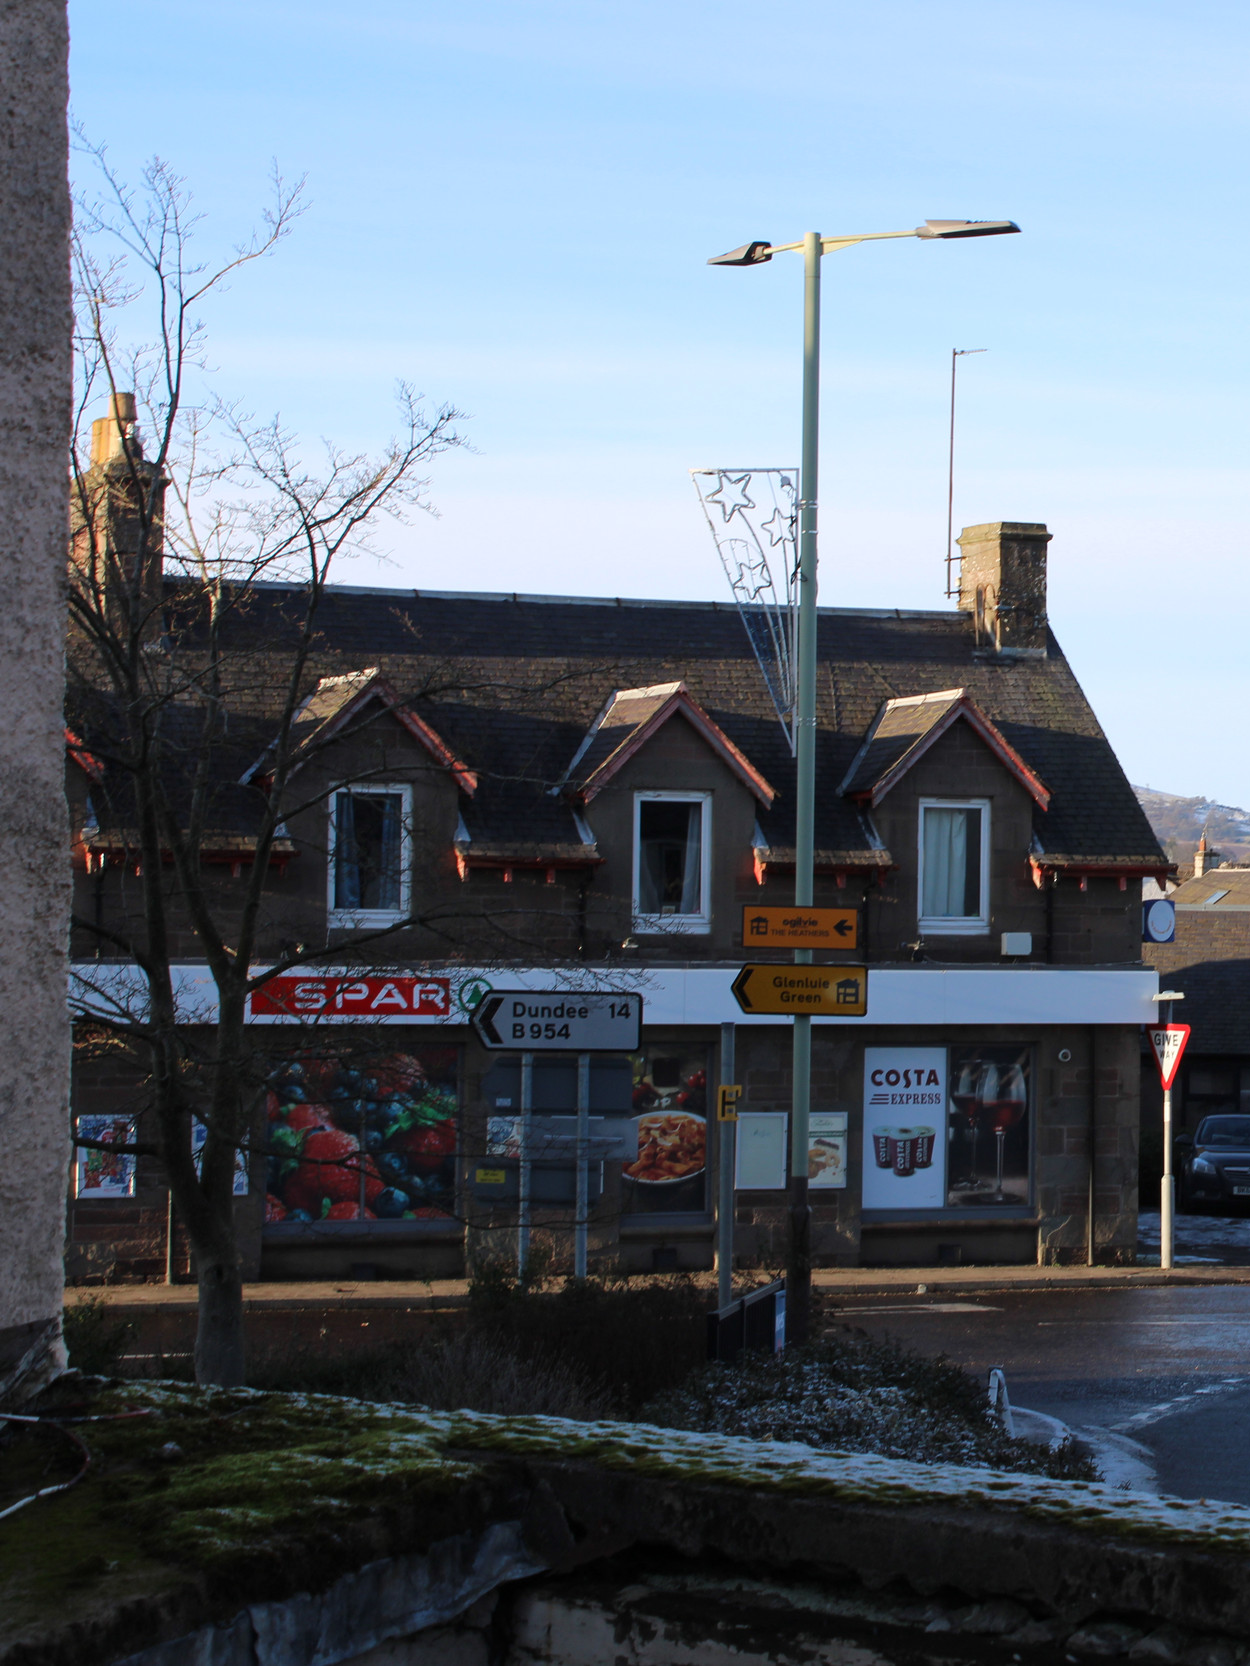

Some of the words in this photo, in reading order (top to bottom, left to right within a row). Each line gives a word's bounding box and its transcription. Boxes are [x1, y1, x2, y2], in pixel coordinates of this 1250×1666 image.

[782, 917, 818, 928] ogilvie
[788, 929, 830, 937] HEATHERS
[294, 982, 446, 1009] SPAR
[780, 991, 822, 1003] Green
[512, 1002, 589, 1018] Dundee
[608, 1003, 631, 1019] 14
[1154, 1033, 1178, 1046] GIVE
[1160, 1050, 1175, 1059] WAY
[871, 1069, 940, 1088] COSTA
[891, 1093, 941, 1105] EXPRESS
